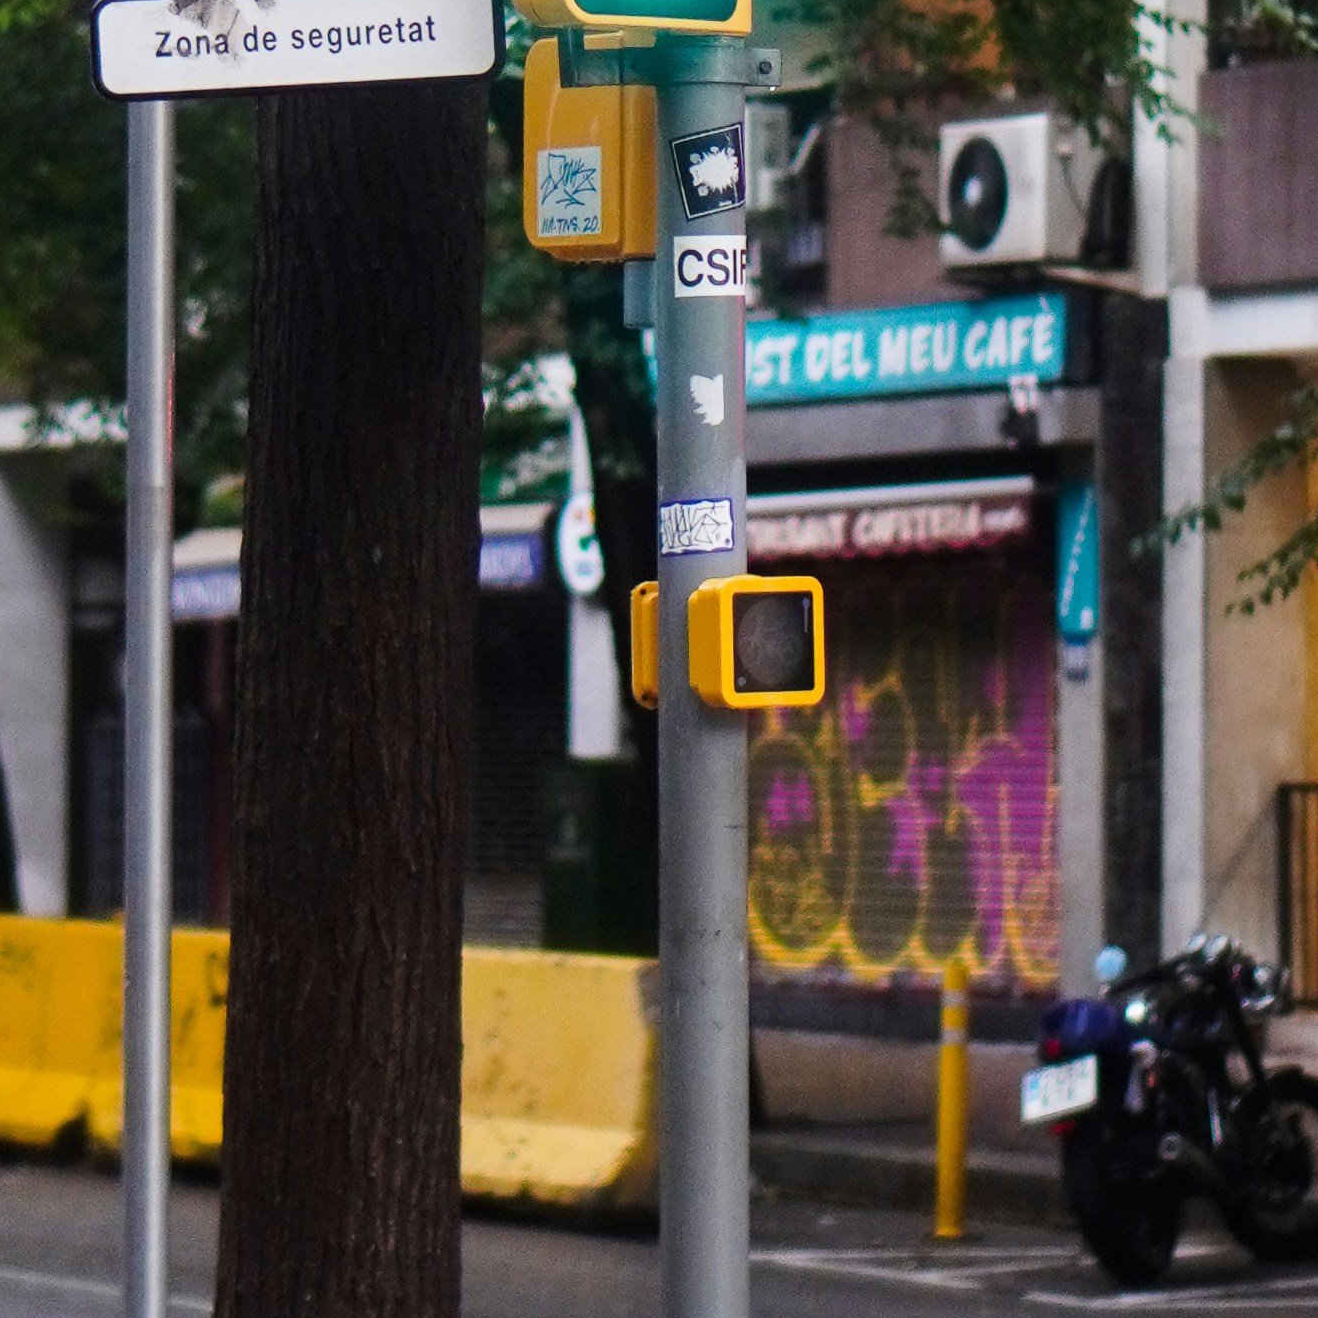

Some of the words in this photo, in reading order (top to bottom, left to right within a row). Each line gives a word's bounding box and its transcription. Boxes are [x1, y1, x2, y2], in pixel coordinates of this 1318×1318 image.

[154, 31, 230, 58] Zona
[243, 24, 277, 53] de
[291, 14, 437, 54] seguretat
[804, 330, 871, 382] DEL
[878, 320, 957, 378] MEU
